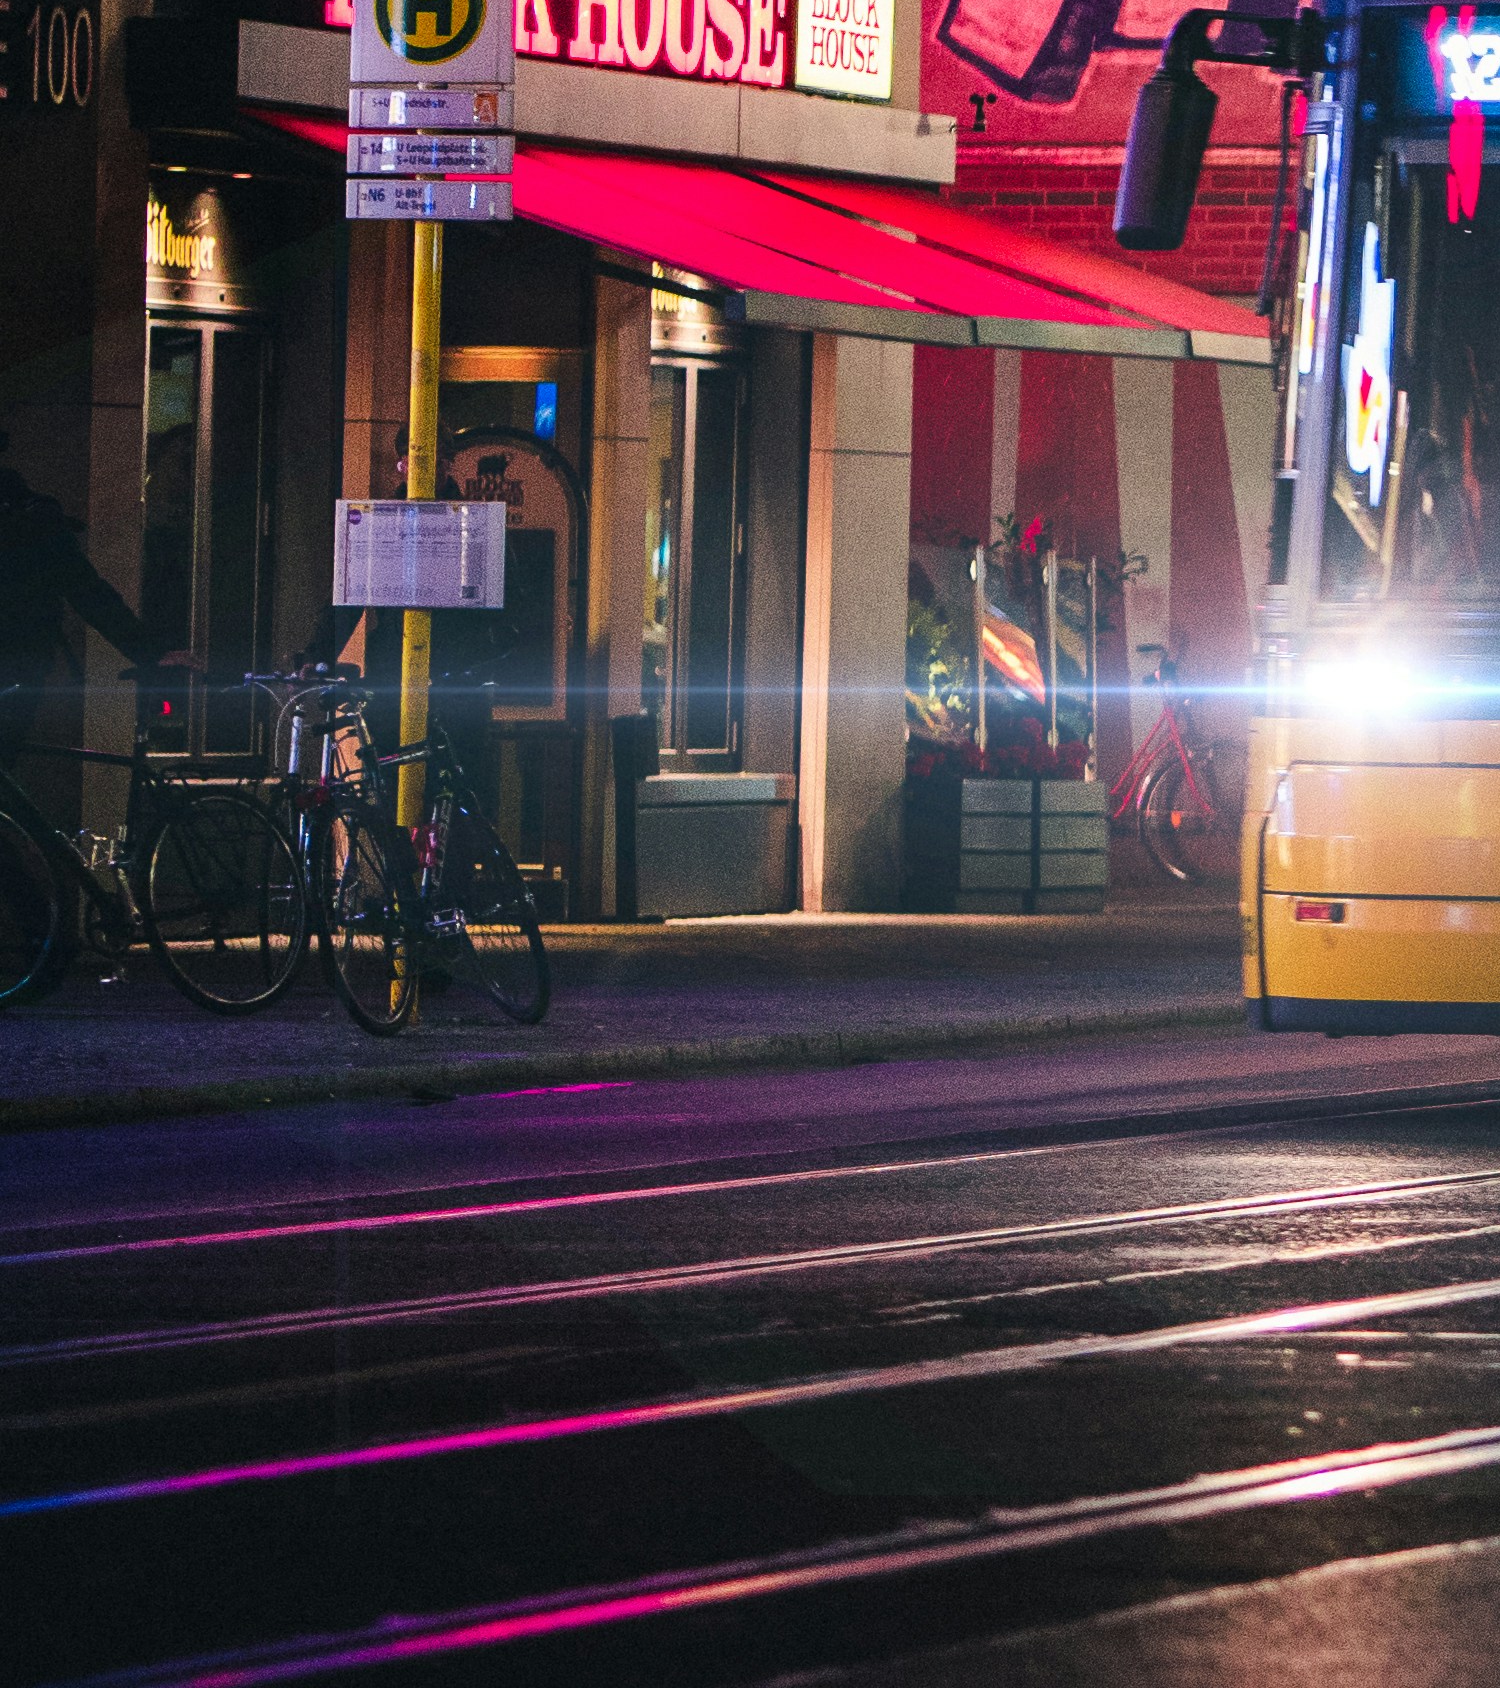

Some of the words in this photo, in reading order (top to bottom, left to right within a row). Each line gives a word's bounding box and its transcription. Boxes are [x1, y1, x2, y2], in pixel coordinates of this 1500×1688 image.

[26, 4, 94, 106] 100
[809, 24, 881, 75] HOUSE
[368, 188, 385, 202] N6
